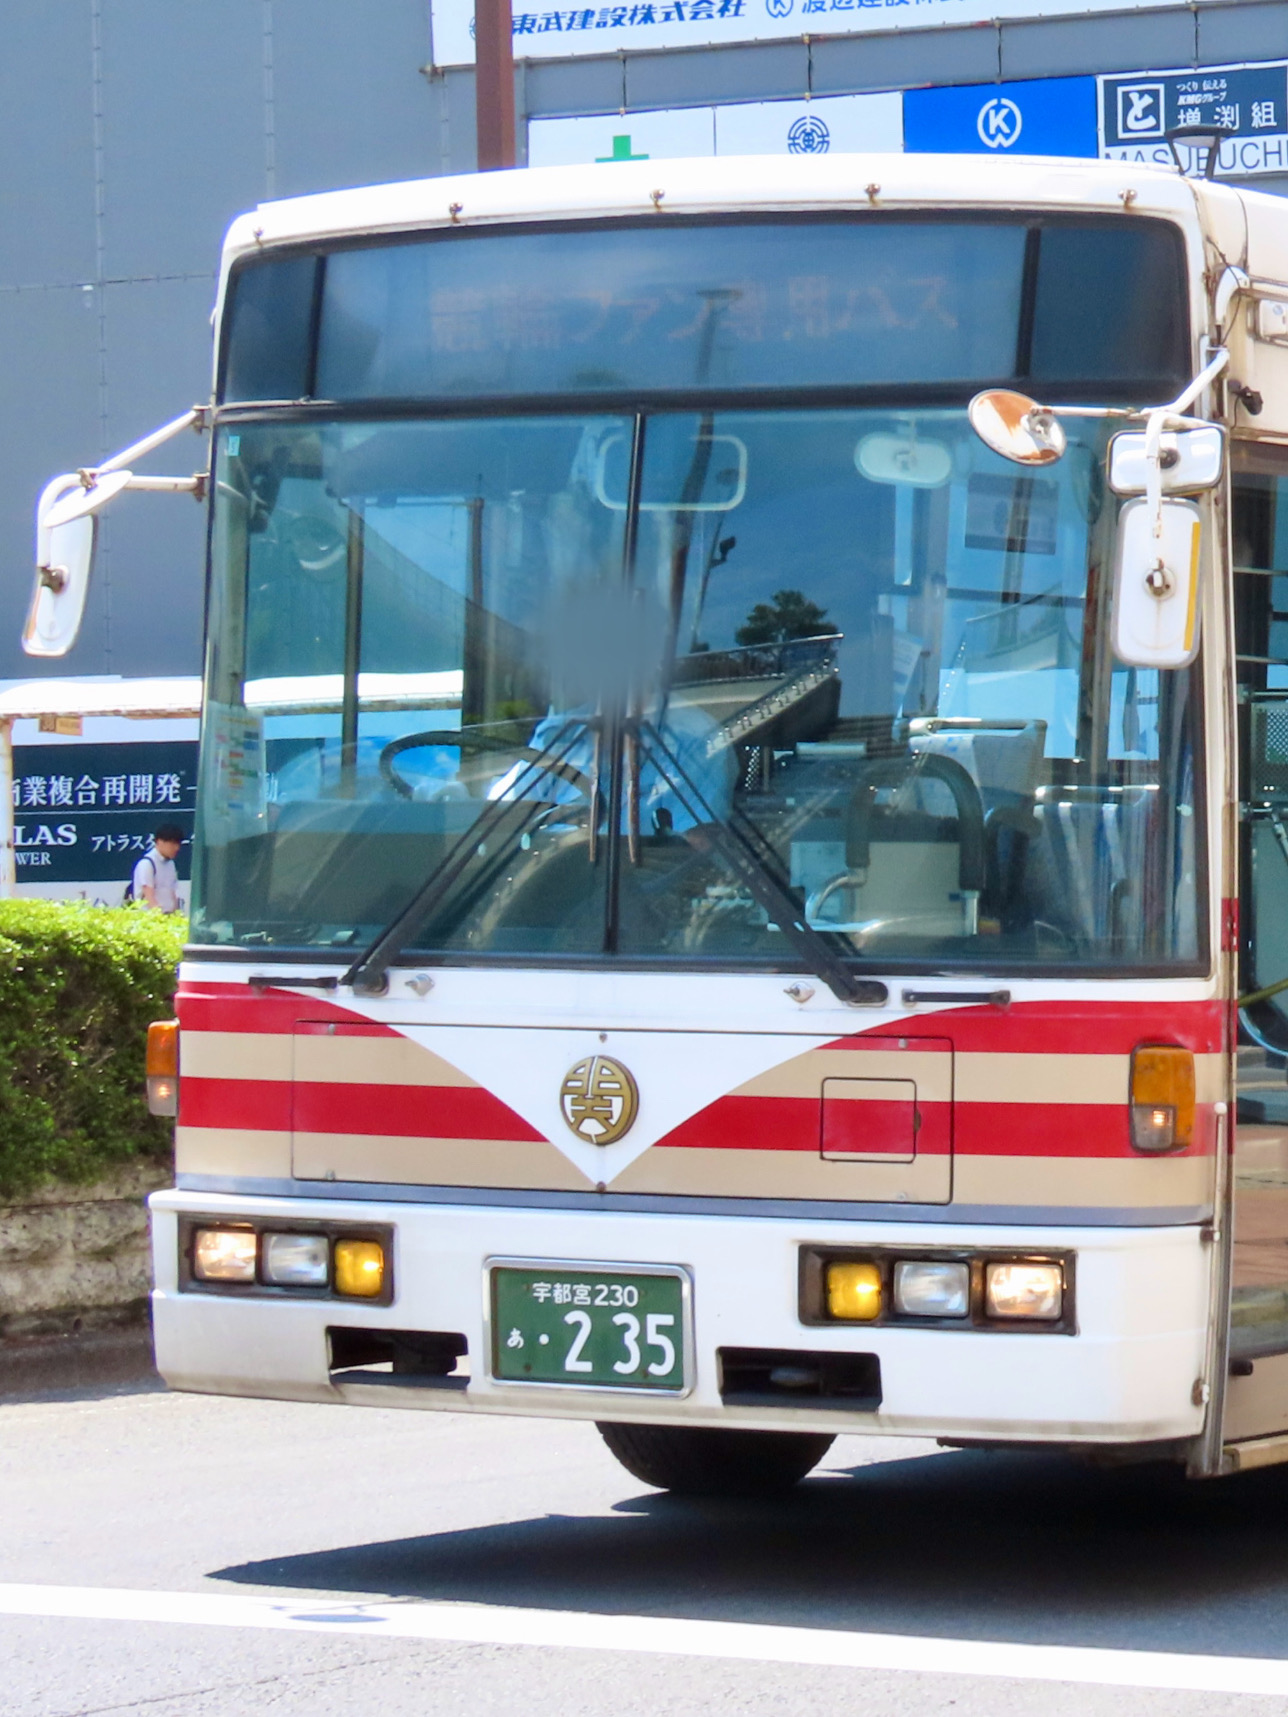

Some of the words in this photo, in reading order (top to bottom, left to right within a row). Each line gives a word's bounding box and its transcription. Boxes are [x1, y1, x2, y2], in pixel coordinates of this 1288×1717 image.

[512, 0, 748, 35] 東武建設株式会社
[1176, 81, 1199, 92] つくり
[1202, 78, 1228, 91] 伝える
[1126, 91, 1157, 131] と
[506, 1327, 525, 1350] あ
